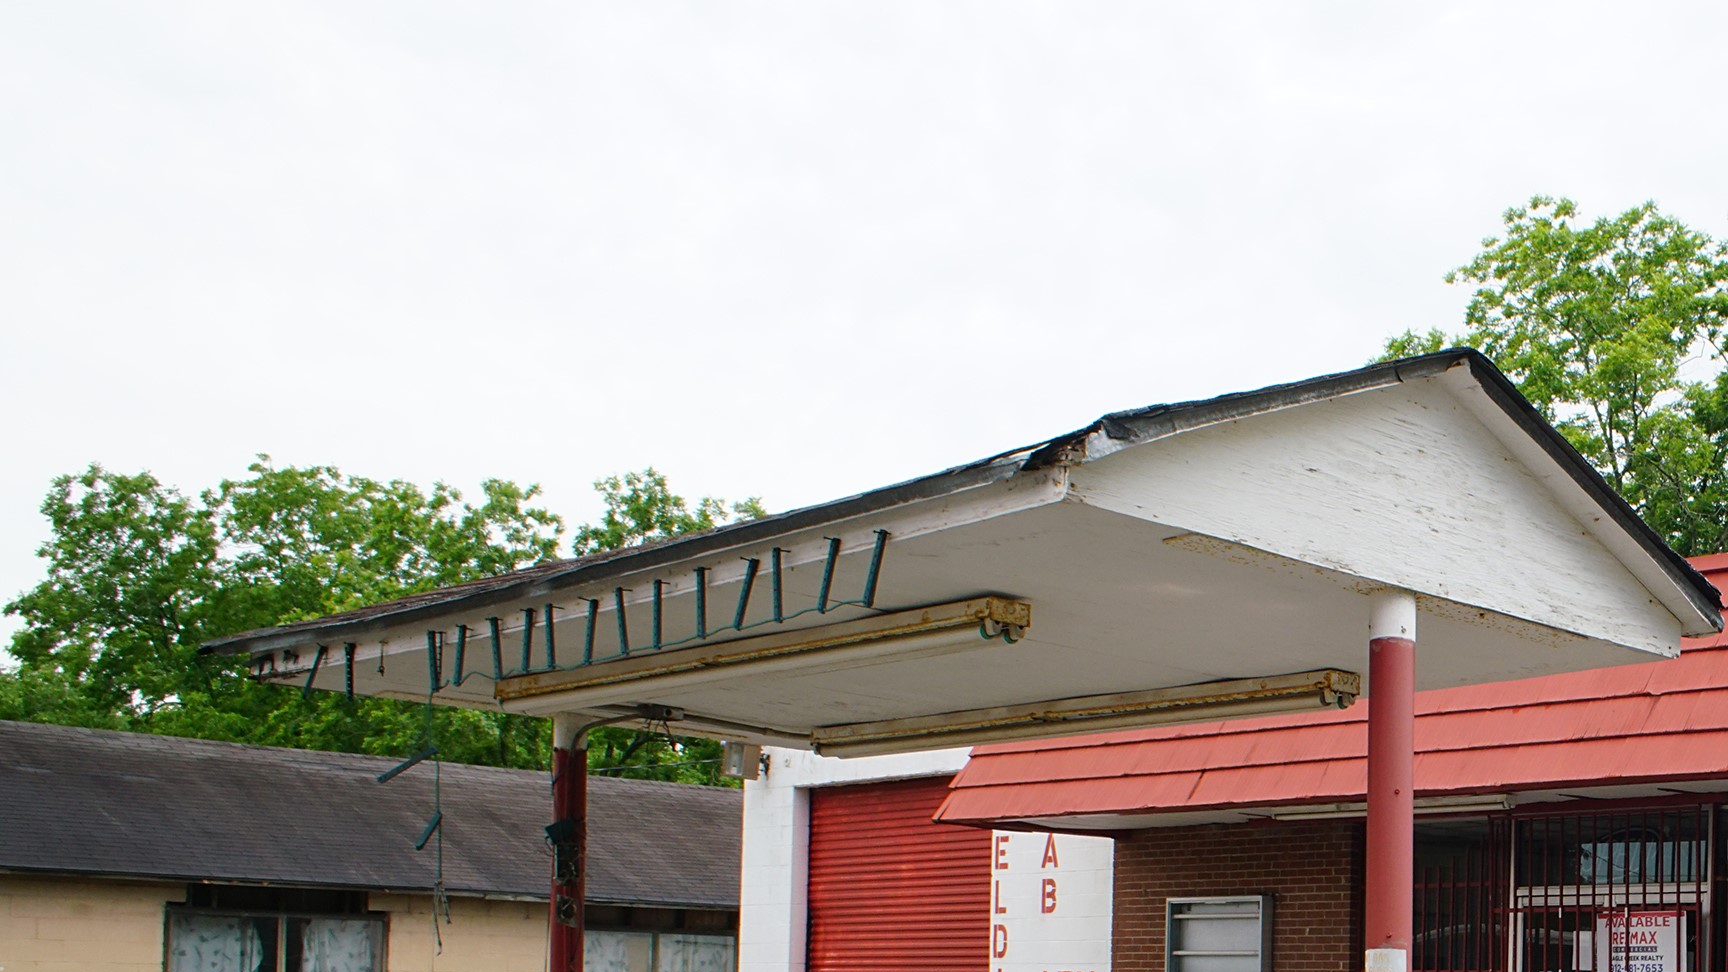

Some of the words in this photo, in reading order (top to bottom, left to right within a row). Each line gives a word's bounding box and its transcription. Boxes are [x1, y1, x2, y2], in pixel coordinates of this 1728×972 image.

[1605, 916, 1670, 928] AVALABLE
[1612, 931, 1657, 945] REMAX
[1611, 963, 1664, 972] 912-81-7653
